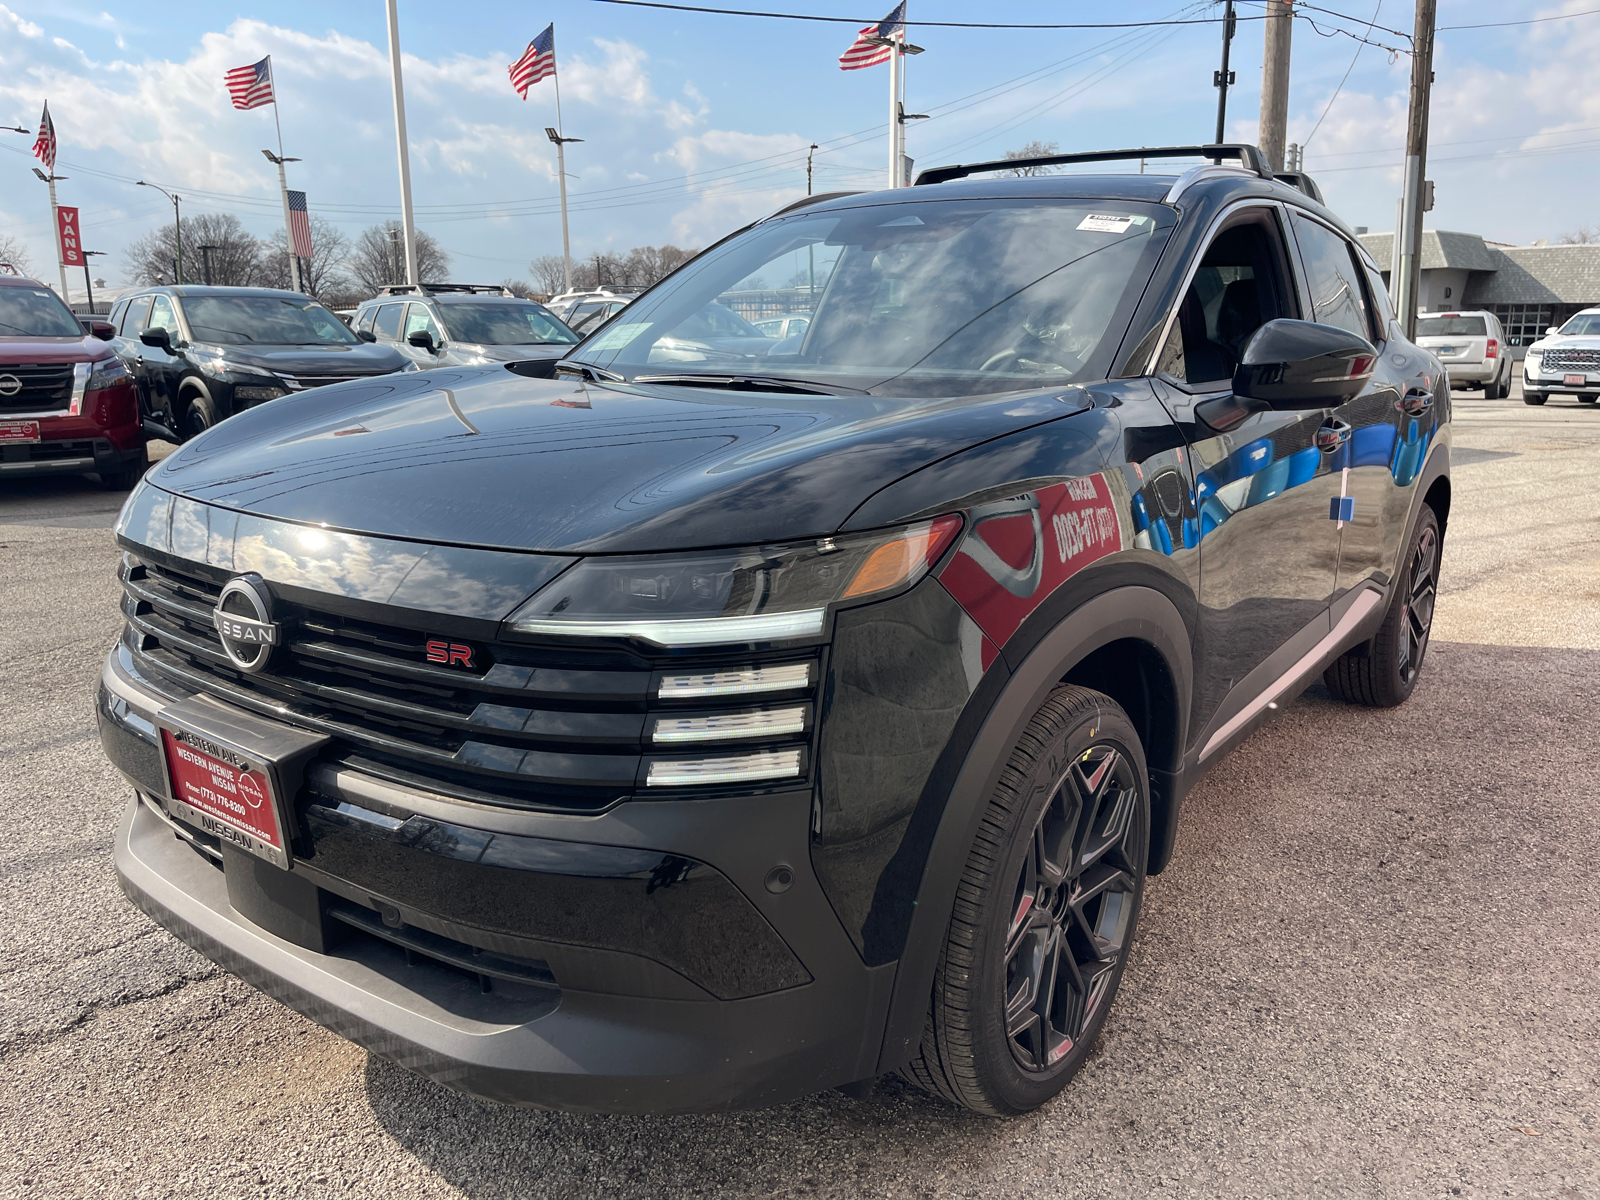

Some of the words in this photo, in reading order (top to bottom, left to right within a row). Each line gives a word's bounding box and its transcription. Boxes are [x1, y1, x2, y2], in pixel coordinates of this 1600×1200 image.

[62, 212, 78, 261] VANS
[213, 614, 273, 642] NISSAN
[426, 640, 473, 668] SR
[178, 728, 221, 758] WESTERN
[176, 746, 208, 770] WESTERN
[208, 761, 235, 782] AVENUE
[211, 774, 237, 795] NISSAN
[237, 783, 264, 799] NISSAN
[200, 787, 217, 804] (773)
[216, 793, 246, 816] 776-8200
[187, 795, 272, 841] www.westernavenissan.com
[202, 815, 253, 851] NISSAN
